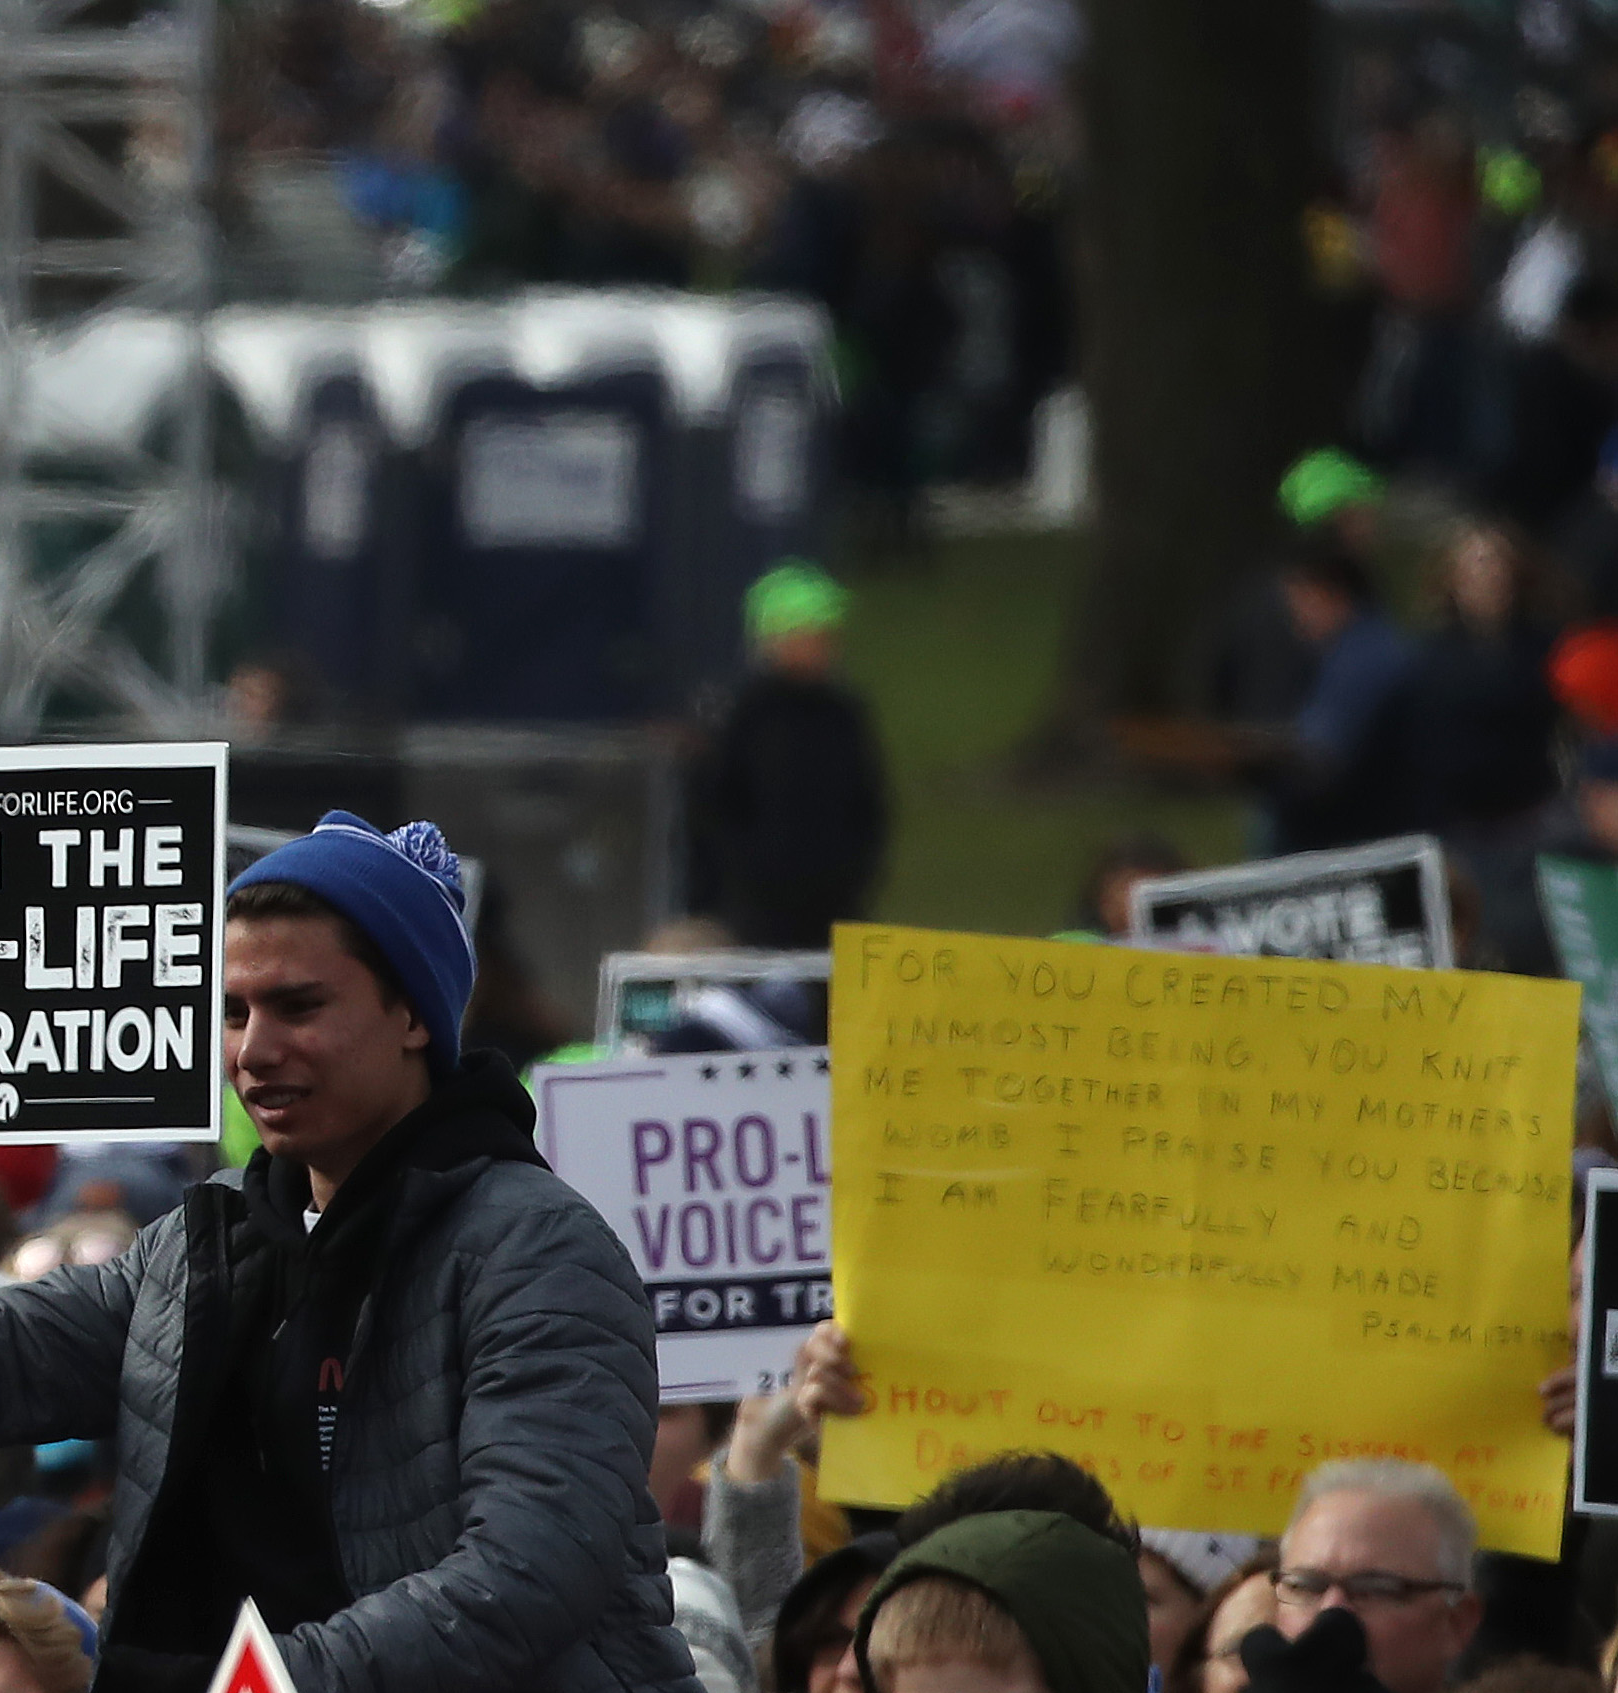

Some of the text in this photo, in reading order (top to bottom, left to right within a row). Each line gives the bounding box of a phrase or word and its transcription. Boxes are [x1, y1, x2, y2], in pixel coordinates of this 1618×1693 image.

[38, 825, 184, 888] THE
[861, 934, 1468, 1024] FOR YOU CREATED MY
[884, 1015, 1081, 1051] INMOST
[1298, 1037, 1389, 1075] YOU
[1420, 1047, 1522, 1081] KNIT
[864, 1066, 922, 1099] ME
[956, 1066, 1165, 1107] TOGETHER
[1270, 1090, 1325, 1123] MY
[630, 1111, 832, 1197] PRO-L
[882, 1119, 1570, 1203] WOMB I PRAISE YOU BECAUSE
[874, 1170, 1421, 1251] I AM FEARFULLY AND
[655, 1278, 834, 1327] FOR TR
[1042, 1245, 1439, 1299] WONDERFULLY MADE
[1361, 1309, 1473, 1347] PSALM
[1035, 1399, 1110, 1431] OUT
[1129, 1411, 1186, 1443] TO
[1205, 1423, 1270, 1451] THE
